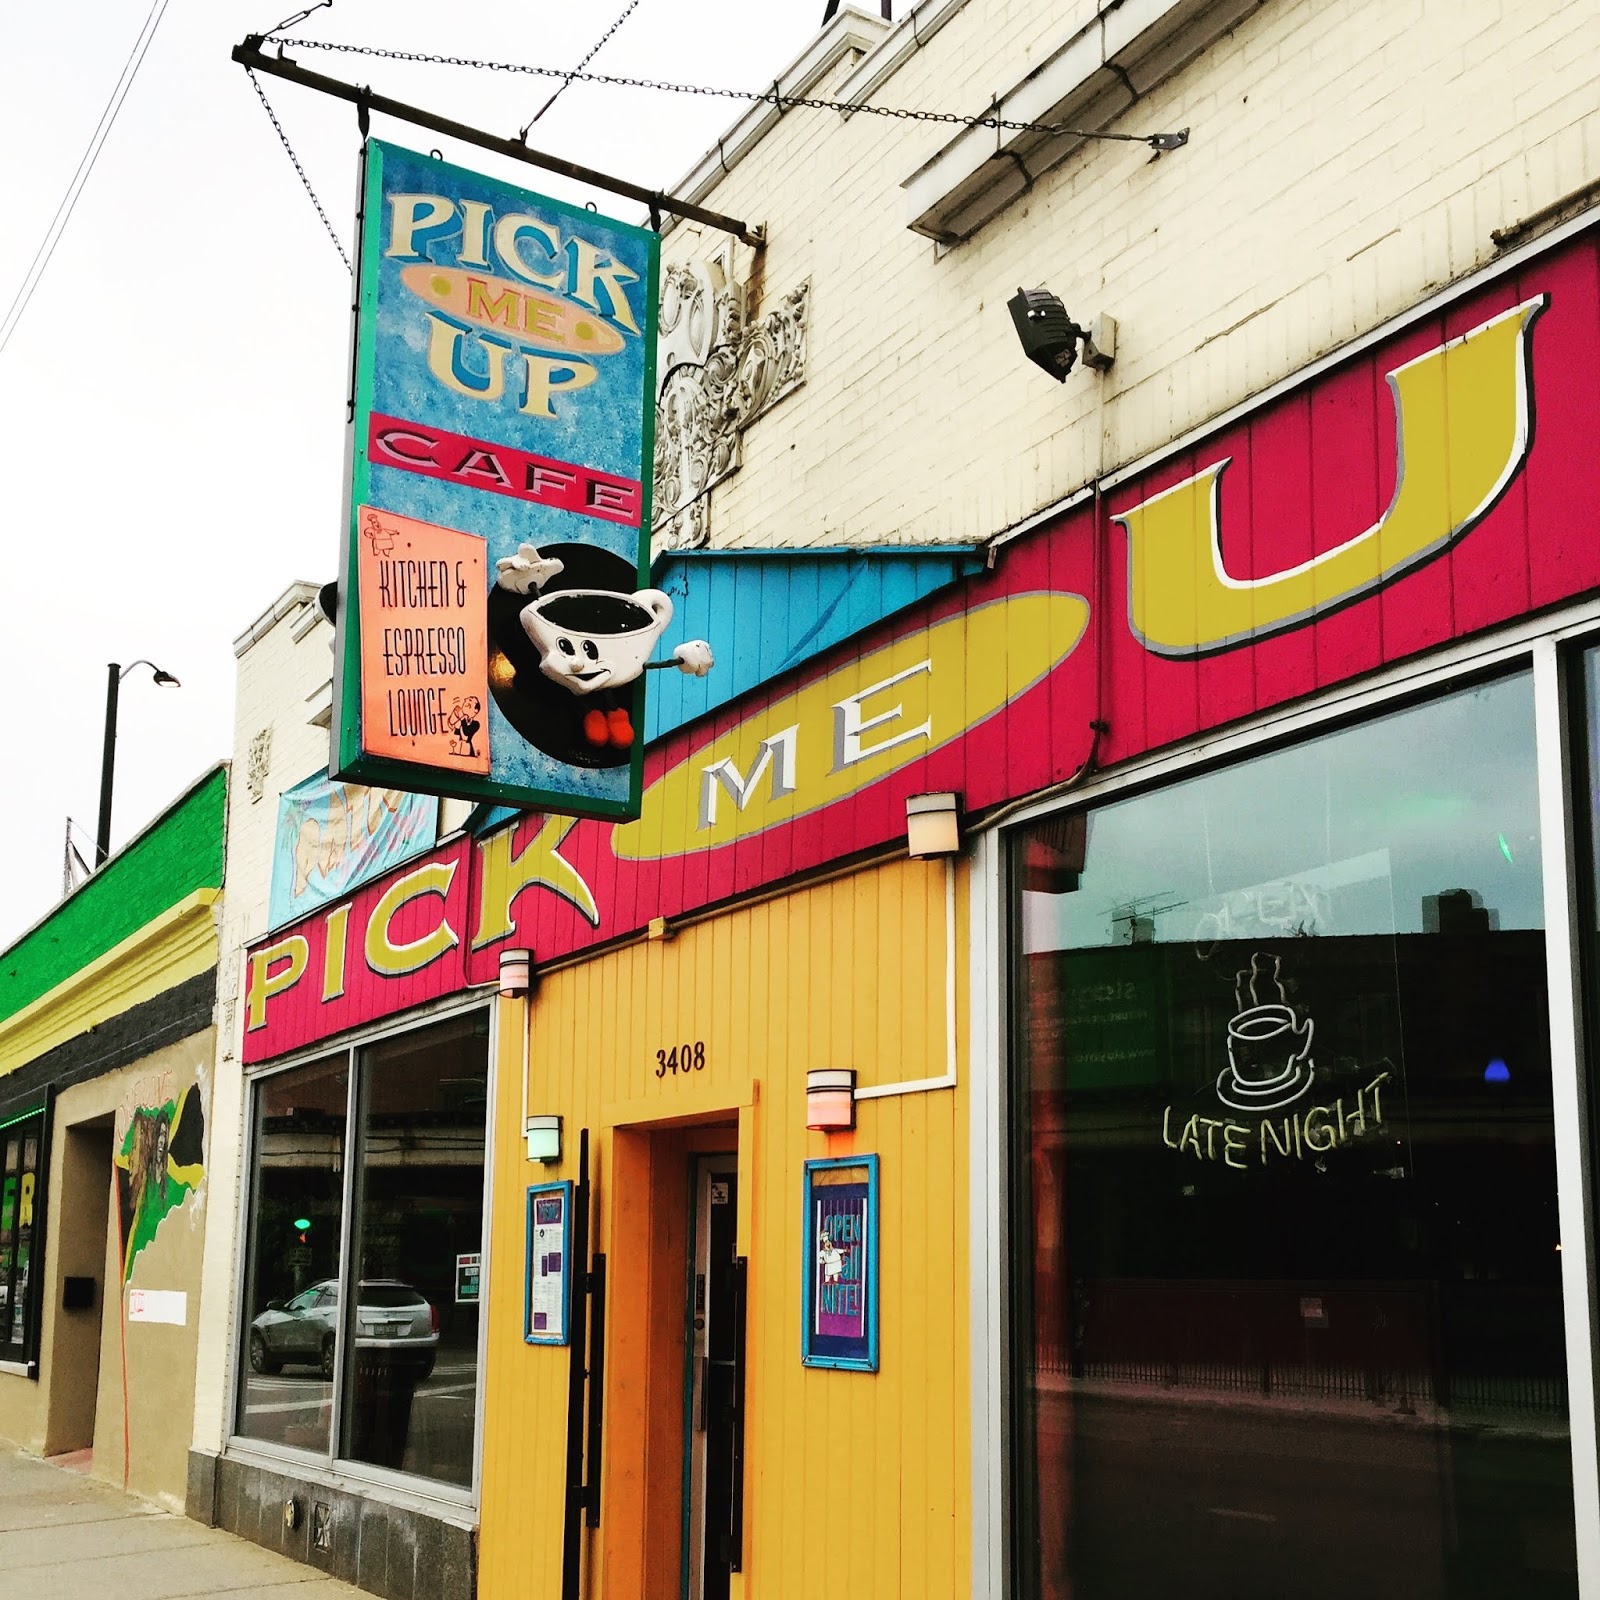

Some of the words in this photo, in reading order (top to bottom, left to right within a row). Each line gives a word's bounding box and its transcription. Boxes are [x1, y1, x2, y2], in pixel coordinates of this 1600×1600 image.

[384, 193, 641, 337] PICK
[466, 276, 566, 343] ME
[424, 311, 599, 419] UP
[374, 427, 637, 519] CAFE
[379, 560, 450, 609] KITCHEN
[455, 561, 468, 608] &
[247, 813, 600, 1032] PICK
[696, 658, 932, 832] ME
[1110, 292, 1551, 661] U
[383, 626, 467, 676] ESPRESSO
[388, 687, 449, 737] LOUNGE
[655, 1041, 705, 1079] 3408
[1163, 1105, 1251, 1169] LATE
[1261, 1072, 1388, 1166] NIGHT
[825, 1213, 862, 1244] OPEN
[820, 1284, 860, 1317] NITE!
